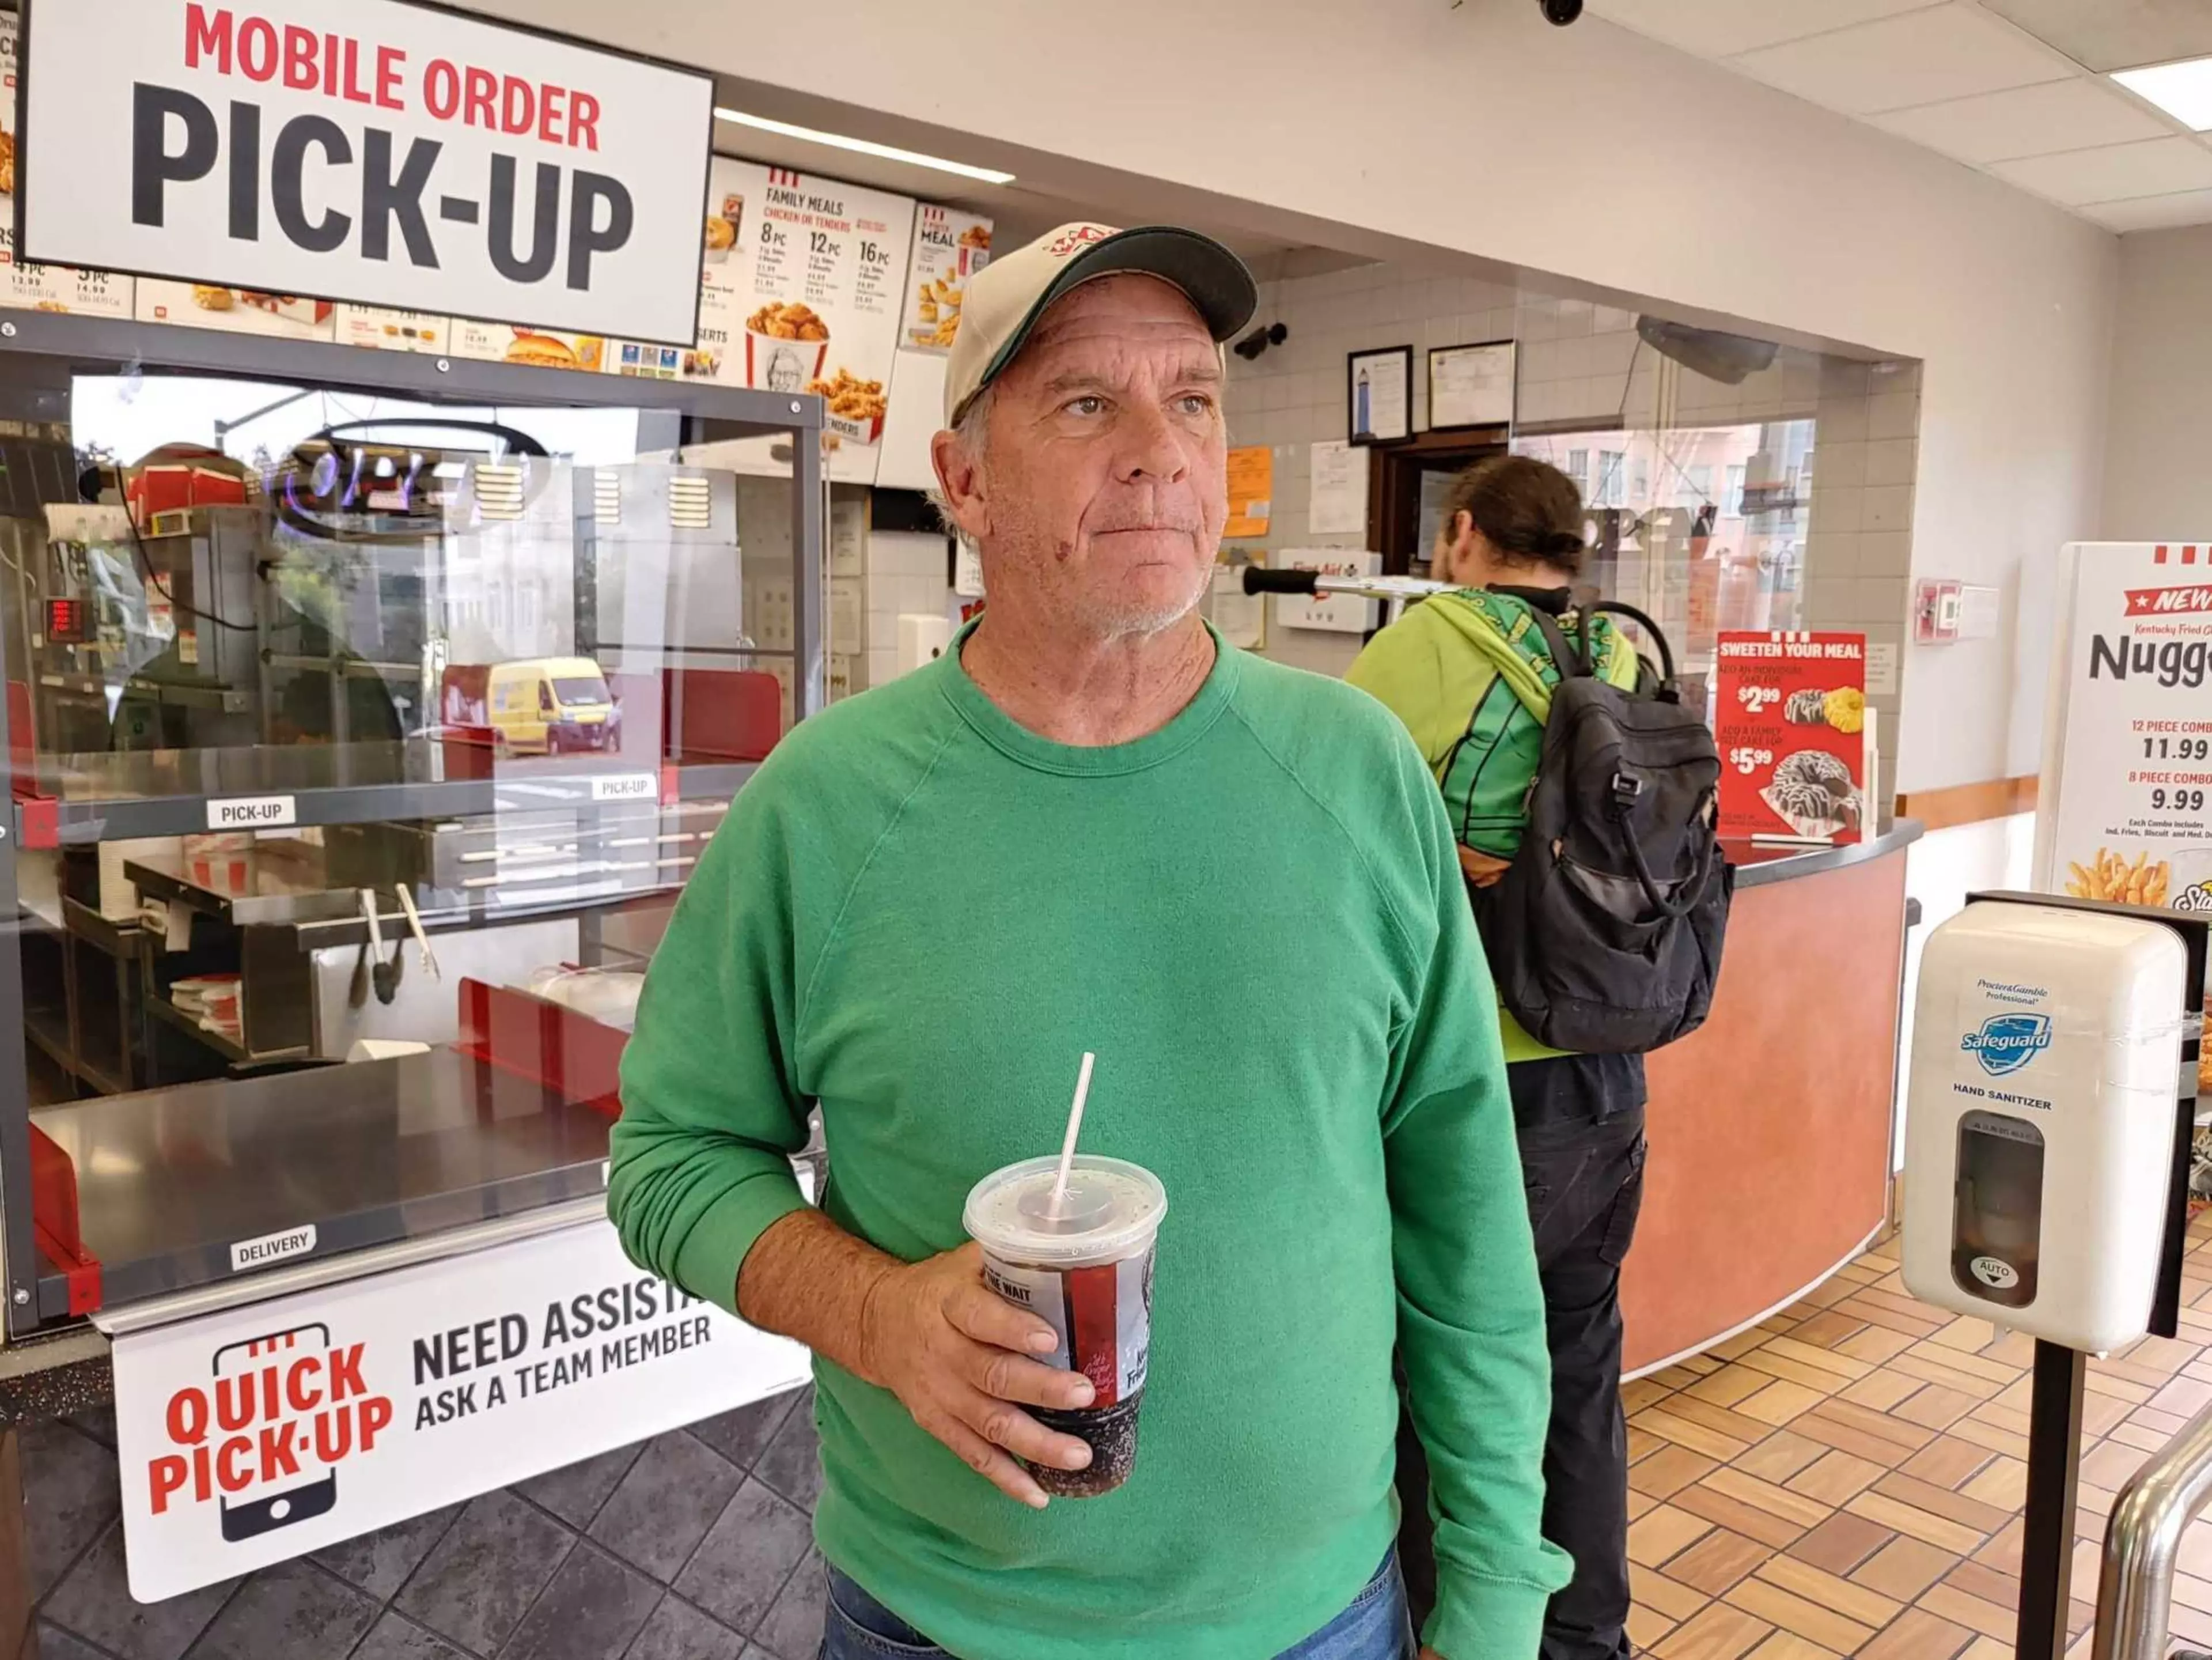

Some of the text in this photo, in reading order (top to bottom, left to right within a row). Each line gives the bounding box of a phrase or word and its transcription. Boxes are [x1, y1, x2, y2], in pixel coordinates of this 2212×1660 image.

[184, 3, 601, 152] MOBILE ORDER
[131, 81, 634, 291] PICK-UP
[766, 188, 844, 216] FAMILY MEALS
[763, 207, 801, 223] CHICKEN
[801, 213, 813, 225] OR
[815, 215, 851, 233] TENDERS
[761, 222, 787, 246] 8 PC
[810, 231, 841, 256] 12 PC
[921, 230, 955, 247] MEAL
[859, 241, 889, 266] 16 PC
[698, 328, 728, 343] SERTS
[2153, 588, 2212, 611] NEW
[2134, 623, 2176, 636] Kentucky
[2179, 624, 2201, 634] Fried
[1720, 642, 1862, 659] SWEETEN YOUR MEAL
[2133, 720, 2143, 731] 12
[2147, 721, 2179, 732] PIECE
[2143, 738, 2208, 760] 11.99
[602, 780, 647, 795] PICK-UP
[2129, 771, 2212, 784] 8 PIECE COMBO
[2152, 788, 2204, 811] 9.99
[221, 804, 282, 822] PICK-UP
[2129, 819, 2146, 827] Each
[1962, 1033, 2047, 1052] Safeguard
[1953, 1083, 2052, 1110] HAND SANITIZER
[239, 1231, 309, 1264] DELIVERY
[1980, 1262, 2009, 1276] AUTO
[1002, 1281, 1031, 1302] WAIT
[412, 1313, 529, 1386] NEED
[415, 1315, 711, 1431] ASK A TEAM MEMBER
[165, 1342, 370, 1445] QUICK
